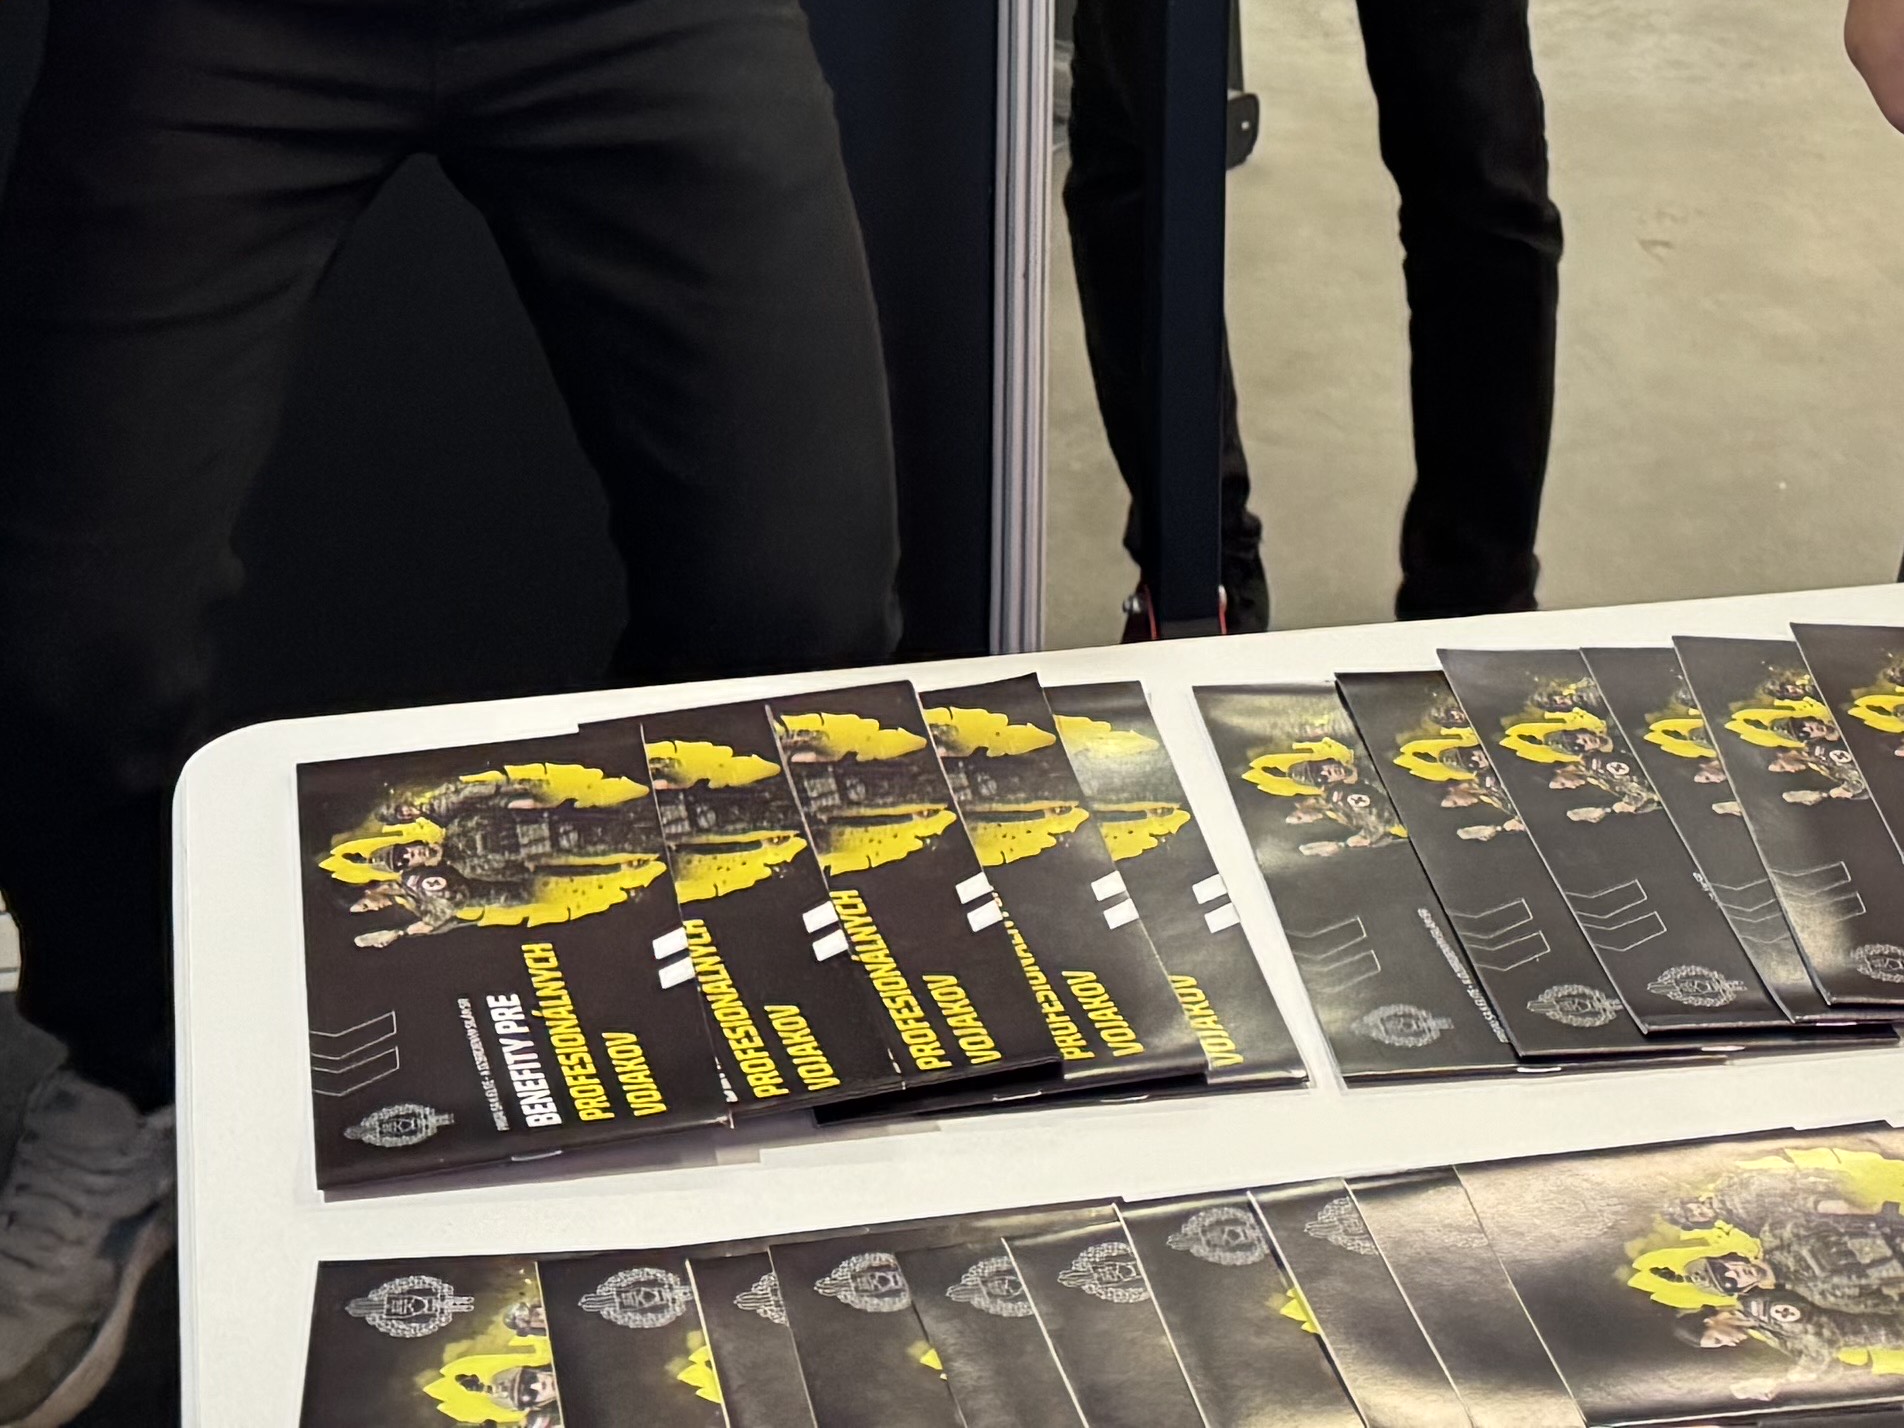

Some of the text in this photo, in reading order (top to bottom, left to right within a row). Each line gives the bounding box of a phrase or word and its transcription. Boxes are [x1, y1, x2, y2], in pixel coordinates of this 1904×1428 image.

[829, 890, 953, 1070] PROFESIONÁLNYCH
[922, 975, 1002, 1064] VOJAKOV
[1061, 970, 1145, 1057] VOJAKOV
[485, 994, 563, 1129] BENEFITY PRE
[521, 942, 615, 1122] PROFESIONÁLNYCH
[602, 1032, 669, 1118] VOJAKOV
[763, 1005, 841, 1091] VOJAKOV
